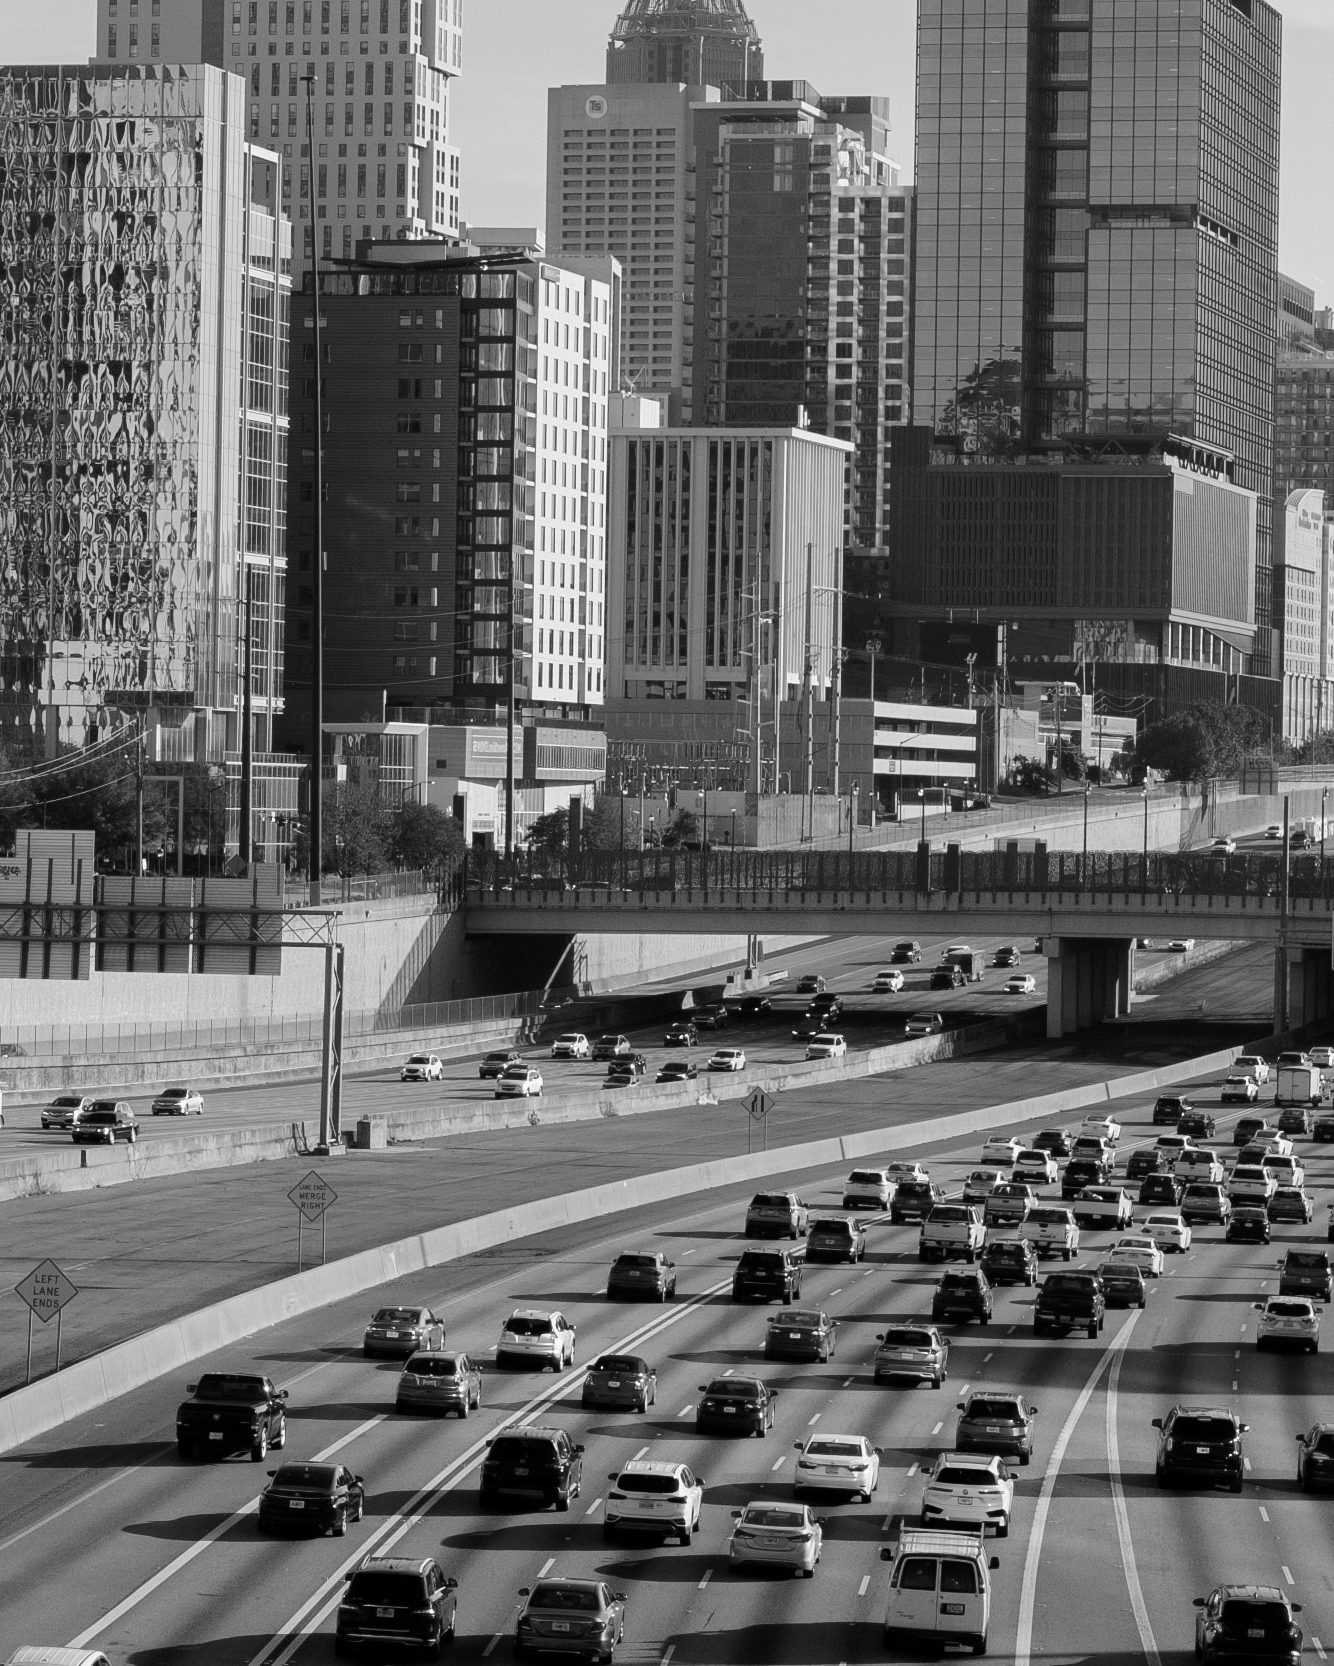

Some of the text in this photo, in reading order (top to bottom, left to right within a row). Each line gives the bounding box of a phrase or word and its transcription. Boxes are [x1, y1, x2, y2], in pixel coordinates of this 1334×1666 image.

[299, 1192, 327, 1200] MERGE
[301, 1201, 325, 1210] RIGHT
[35, 1274, 60, 1284] LEFT
[33, 1286, 60, 1297] LANE
[32, 1298, 59, 1309] ENDS
